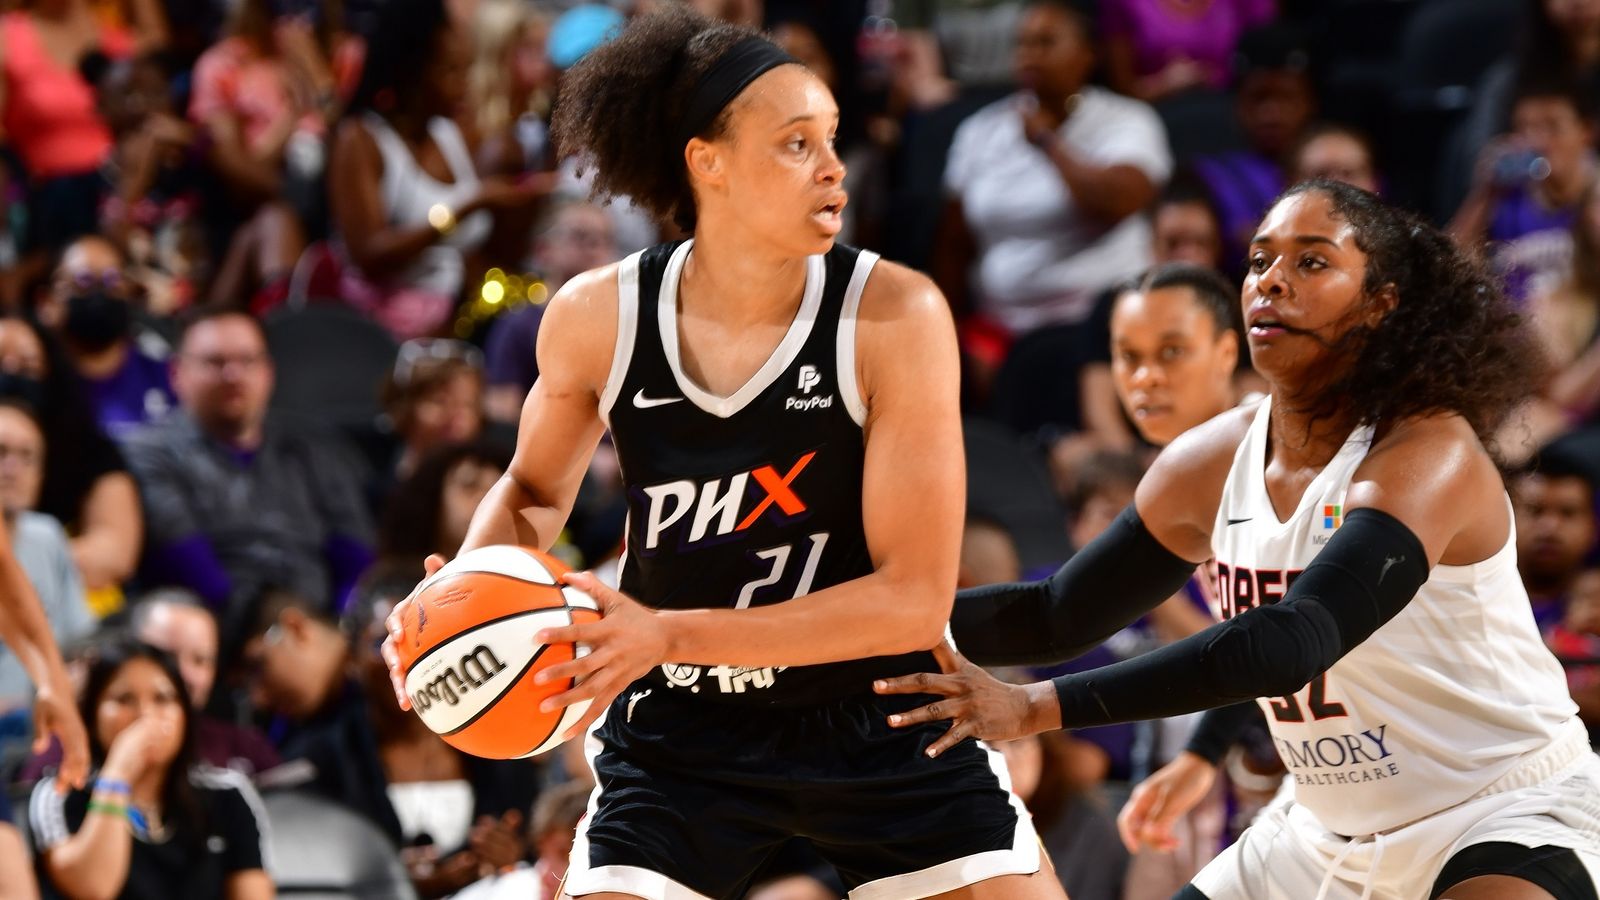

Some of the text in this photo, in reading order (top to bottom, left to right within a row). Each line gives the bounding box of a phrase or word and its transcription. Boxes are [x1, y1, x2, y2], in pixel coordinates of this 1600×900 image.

[785, 394, 833, 411] PayPal
[643, 452, 816, 549] PHX
[1313, 535, 1330, 545] Mic
[735, 533, 830, 609] 21
[411, 645, 507, 714] Wilson
[1276, 725, 1392, 768] MORY
[1295, 763, 1400, 785] EALTHCARE
